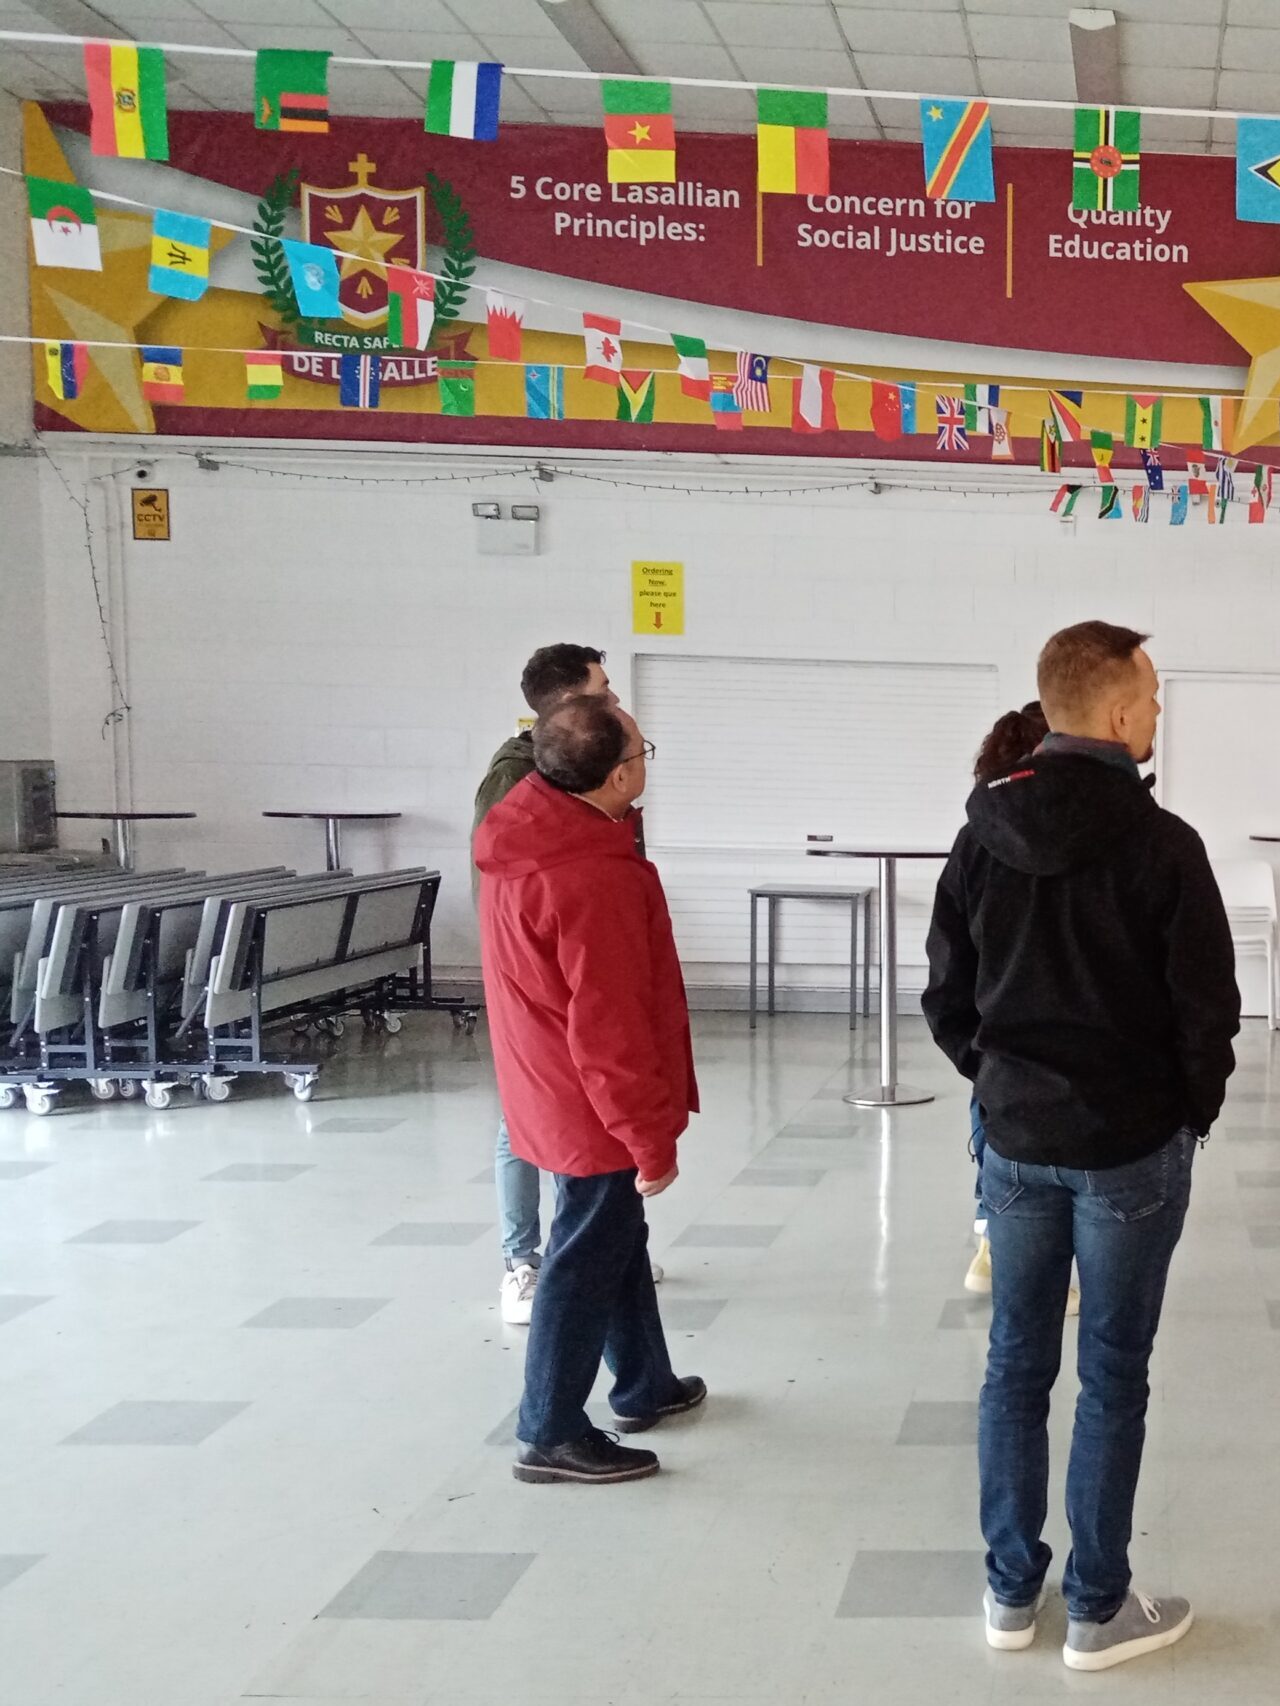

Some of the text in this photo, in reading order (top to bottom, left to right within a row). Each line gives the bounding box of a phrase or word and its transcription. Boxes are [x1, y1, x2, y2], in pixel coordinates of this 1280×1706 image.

[509, 175, 740, 208] 5 Core Lasallian
[806, 193, 977, 219] Concern for
[554, 212, 706, 246] Principles:
[1067, 201, 1172, 234] Quality
[797, 223, 985, 257] Social Justice
[1048, 234, 1189, 263] Education
[314, 331, 404, 349] RECTA SAP
[292, 354, 325, 377] DE
[378, 356, 439, 382] ALLE
